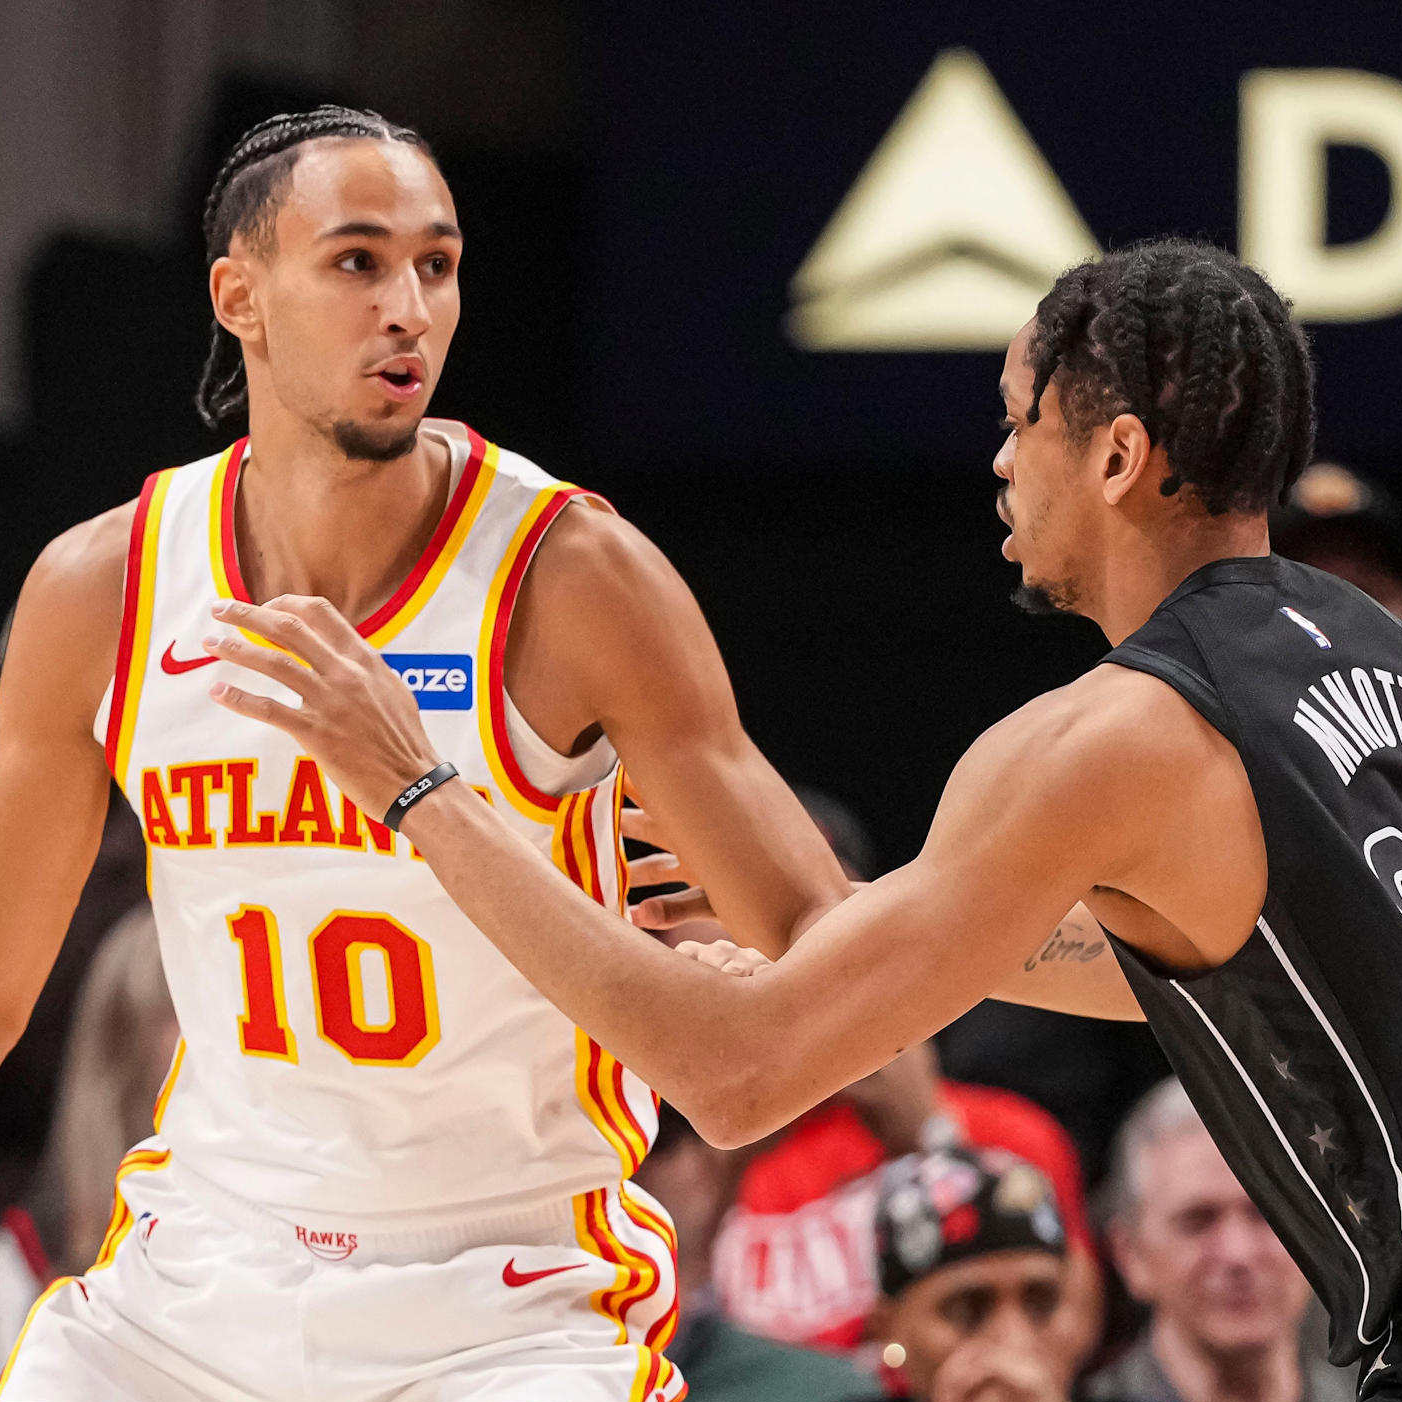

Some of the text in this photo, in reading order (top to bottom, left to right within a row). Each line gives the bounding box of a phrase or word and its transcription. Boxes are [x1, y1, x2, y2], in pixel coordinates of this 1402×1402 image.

[390, 667, 468, 693] aze
[141, 755, 493, 862] ATLAN
[226, 903, 441, 1067] 10
[295, 1225, 358, 1250] HAWKS
